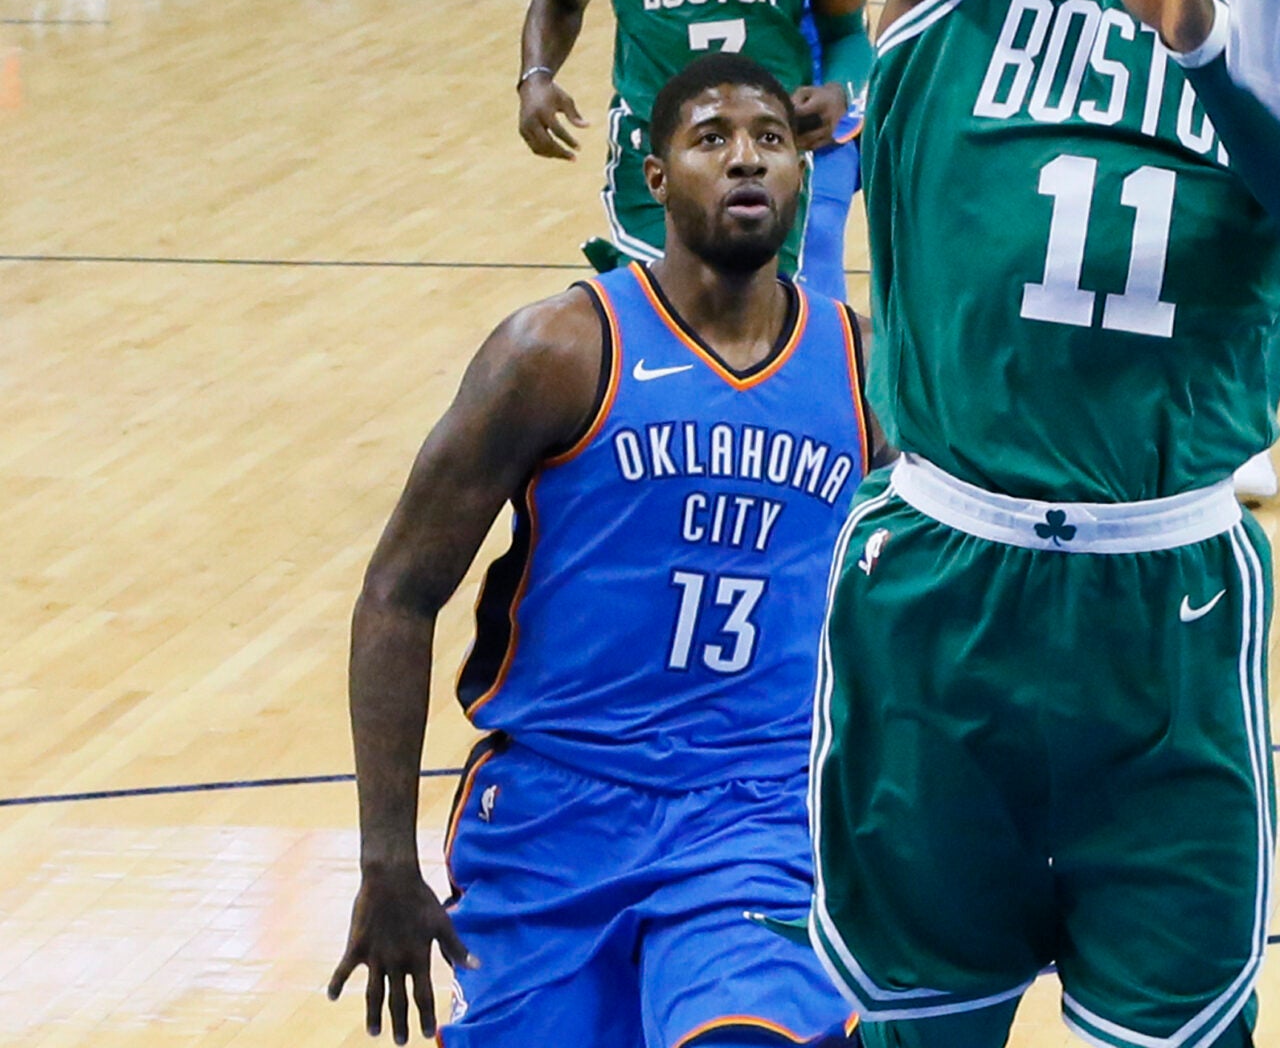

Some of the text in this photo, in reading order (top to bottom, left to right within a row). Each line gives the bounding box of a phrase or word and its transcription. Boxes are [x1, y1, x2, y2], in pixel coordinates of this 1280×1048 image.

[1020, 153, 1178, 339] 11
[614, 423, 853, 503] OKLAHOMA
[682, 494, 782, 551] CITY
[667, 570, 766, 673] 13
